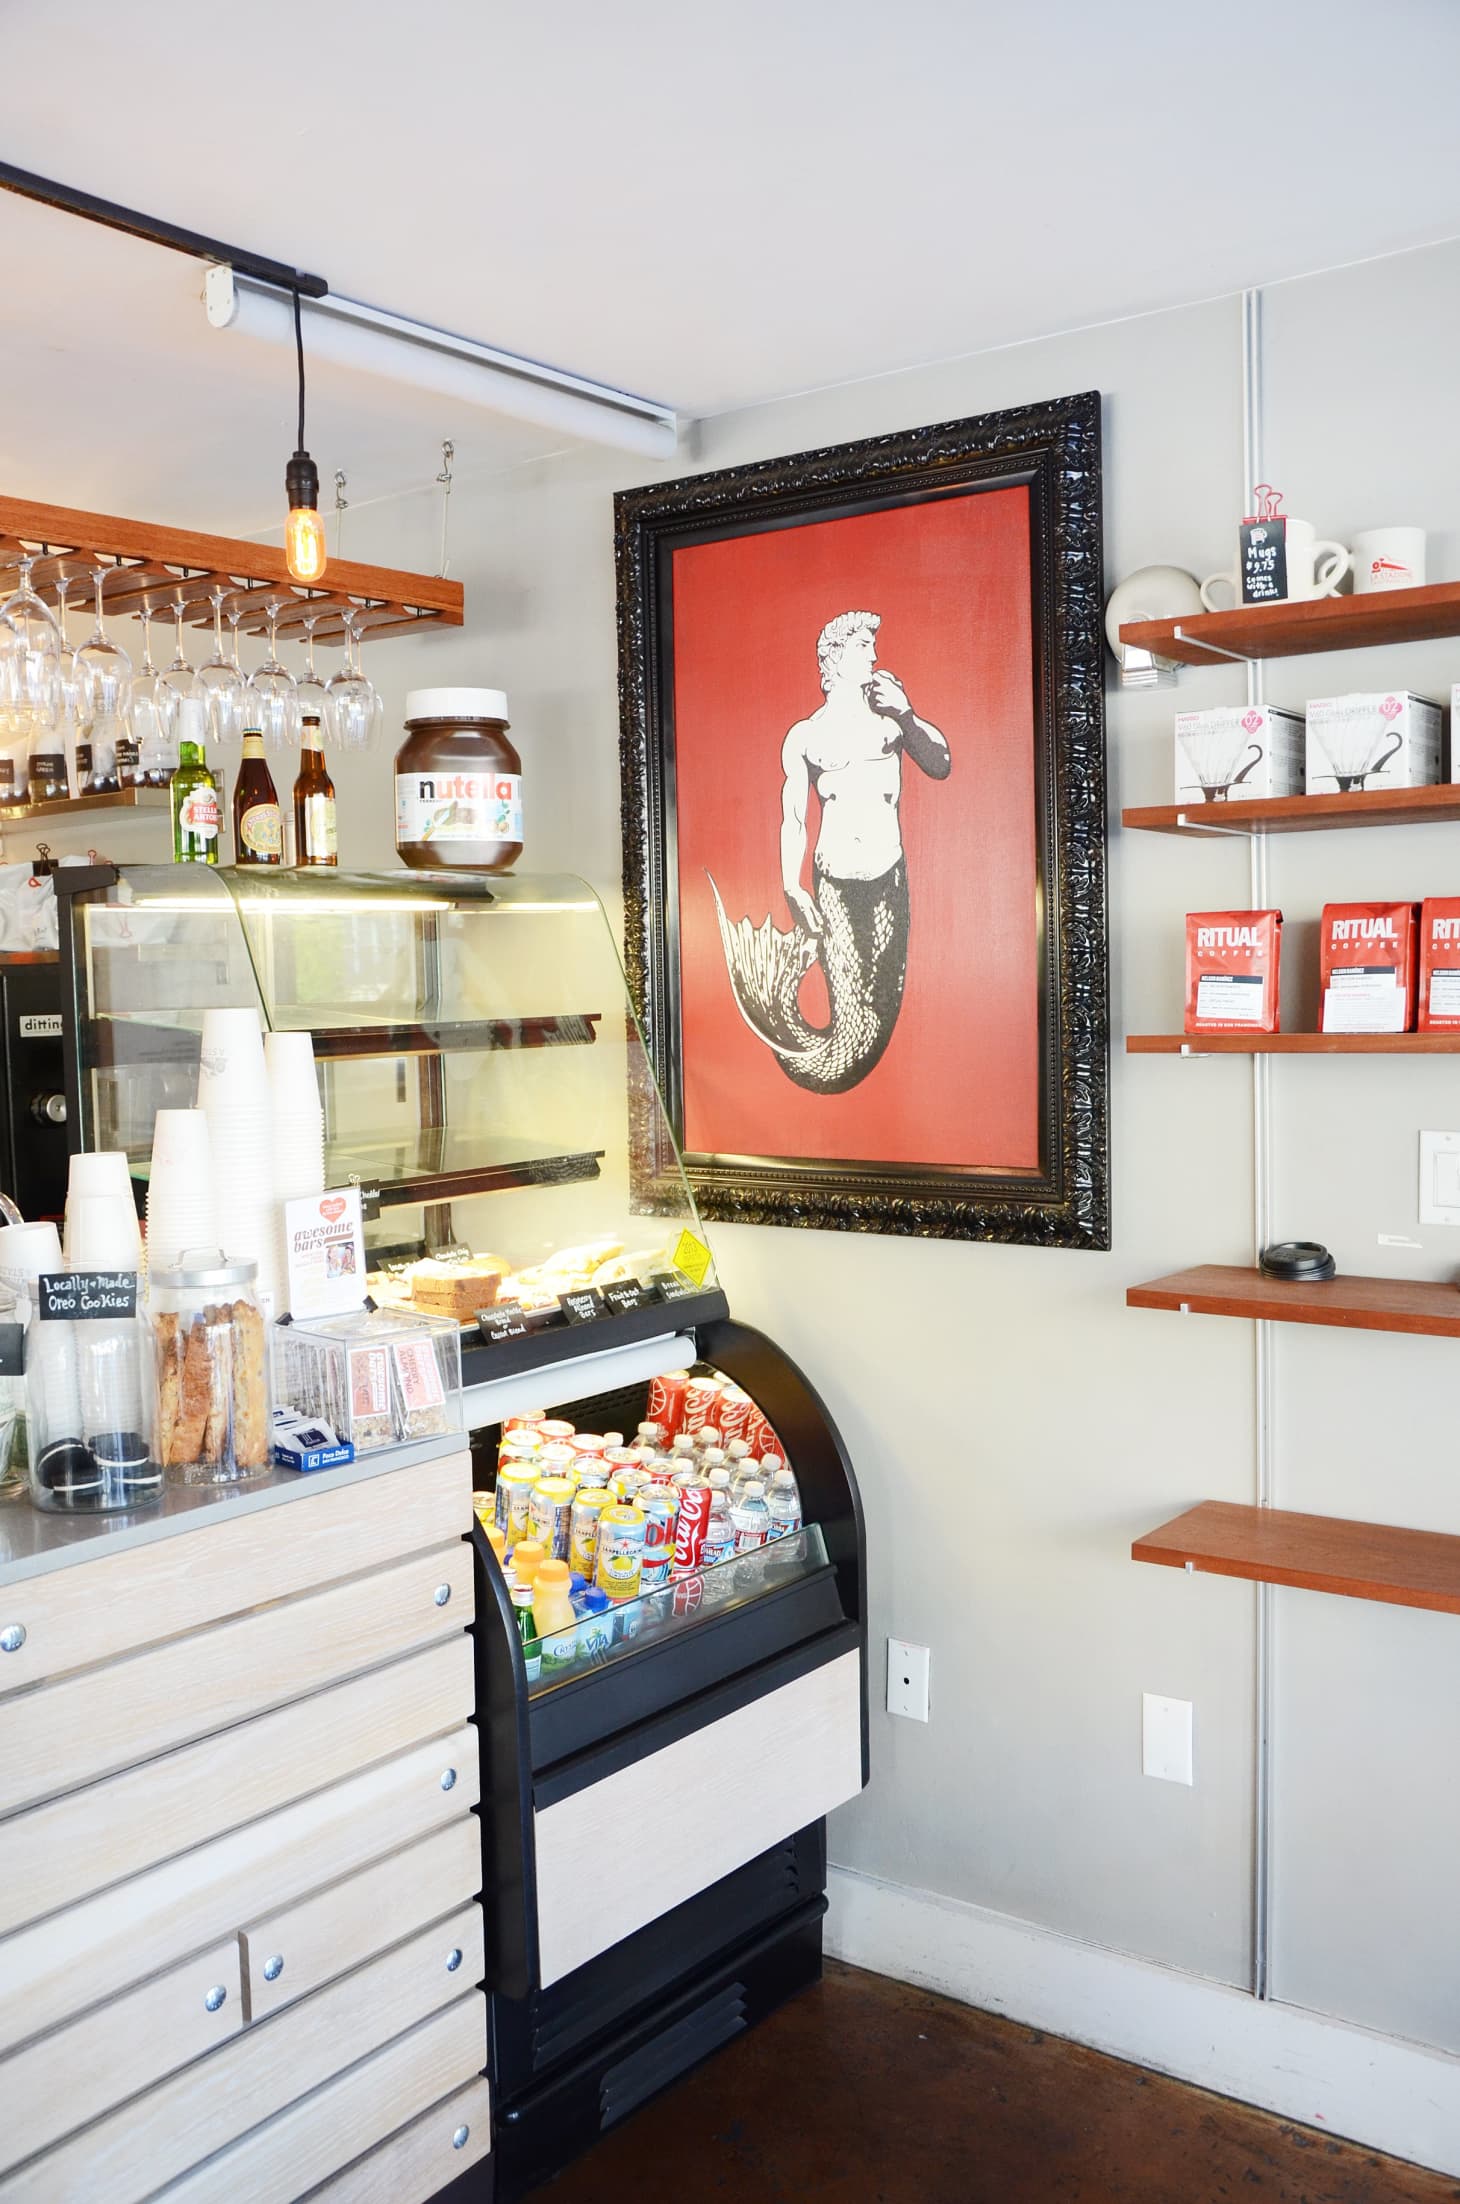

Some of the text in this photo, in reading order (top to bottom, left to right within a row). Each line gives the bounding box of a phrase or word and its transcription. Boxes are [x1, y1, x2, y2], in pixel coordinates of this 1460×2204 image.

[1247, 546, 1277, 561] Mugs
[1246, 560, 1275, 574] $9.75
[1383, 702, 1400, 712] 02
[1246, 716, 1259, 727] 02
[1332, 917, 1399, 940] RITUAL
[1432, 918, 1460, 940] RIT
[1197, 926, 1263, 948] RITUAL
[1331, 941, 1399, 950] COFFEE
[25, 1018, 62, 1031] dittin
[294, 1222, 353, 1241] awesome
[294, 1240, 325, 1253] bars
[43, 1274, 135, 1295] Locally Made
[48, 1294, 76, 1311] Oreo
[407, 1348, 419, 1384] CHERRY
